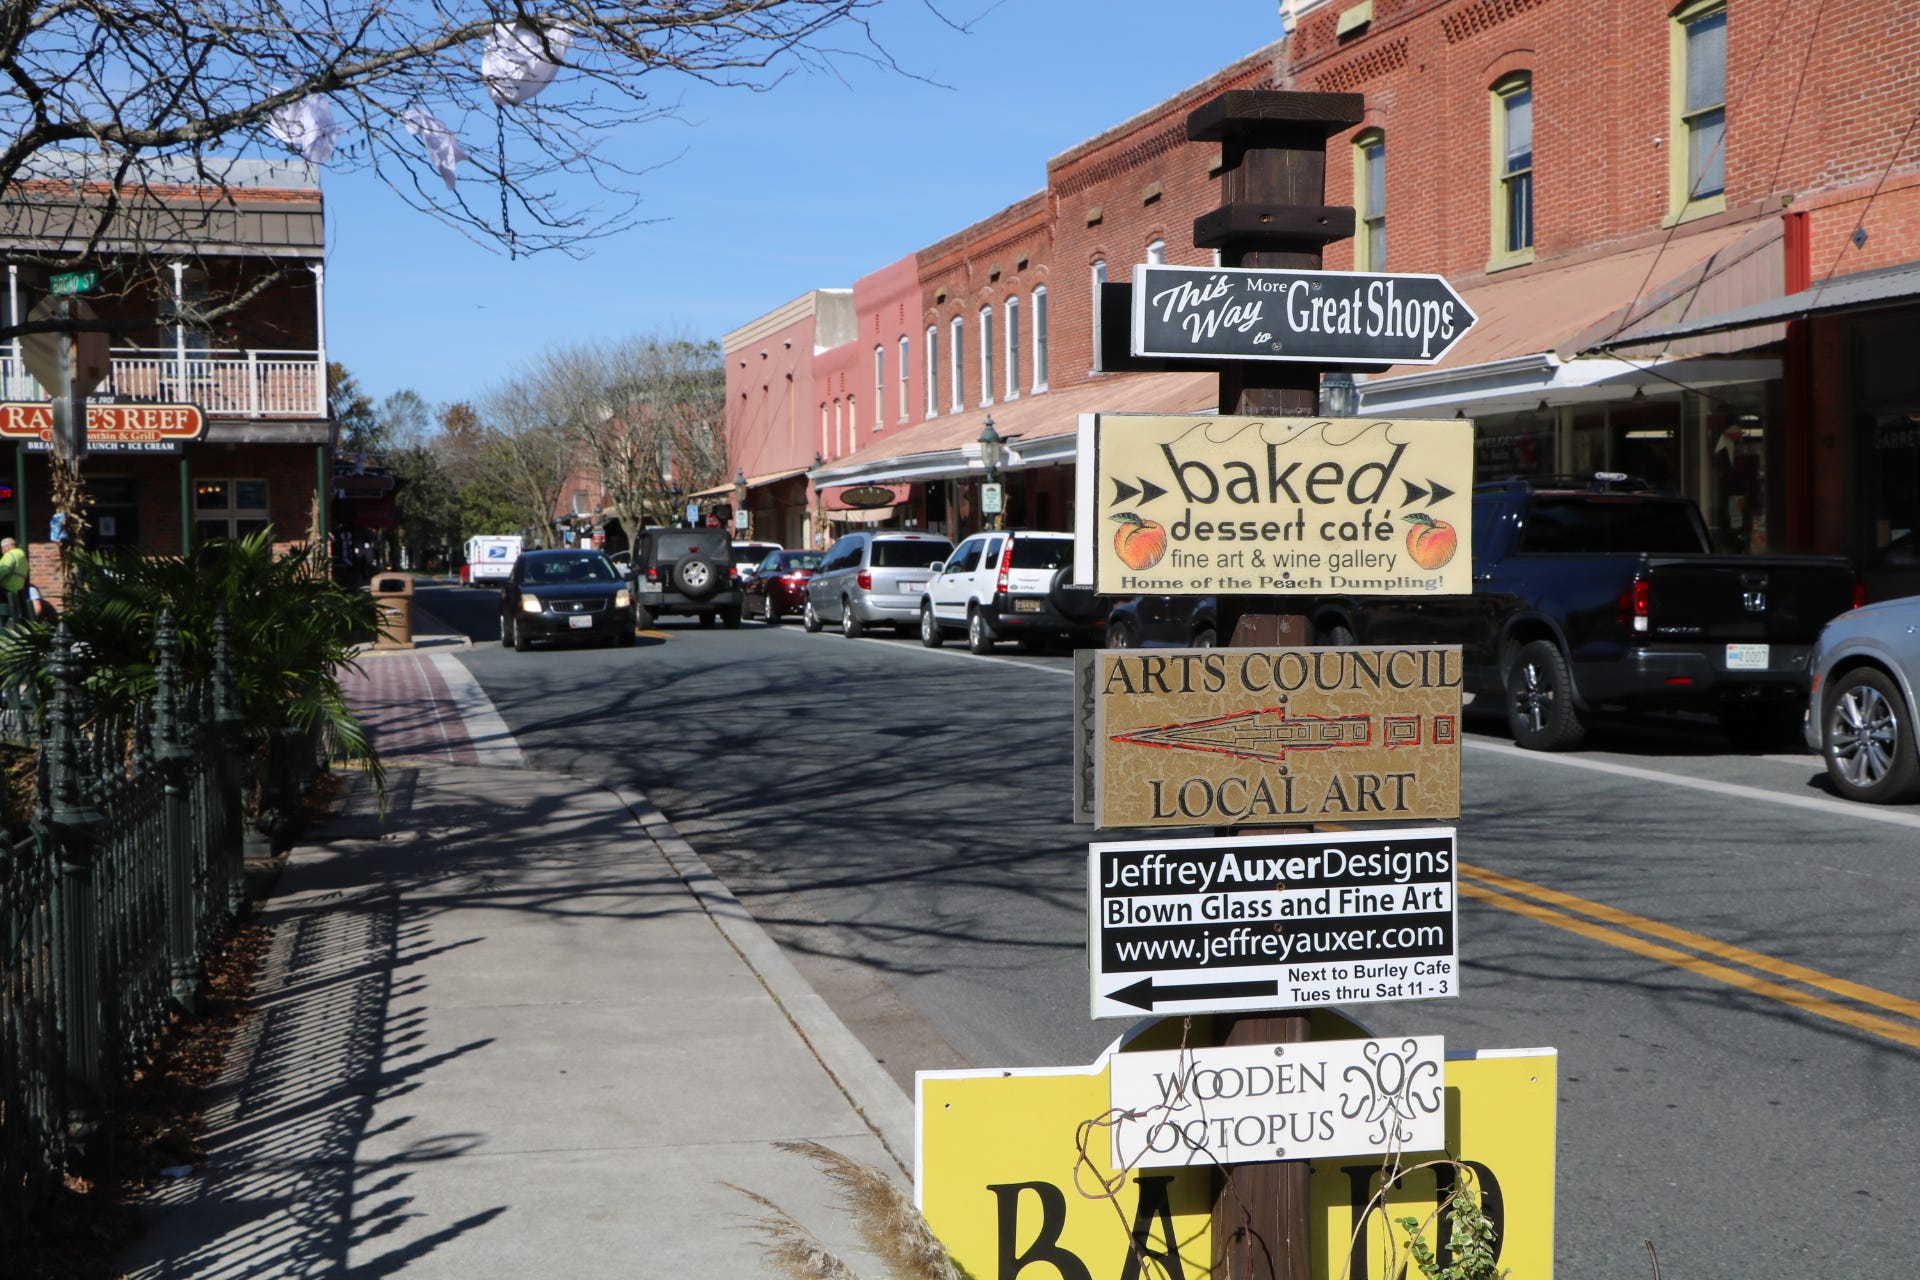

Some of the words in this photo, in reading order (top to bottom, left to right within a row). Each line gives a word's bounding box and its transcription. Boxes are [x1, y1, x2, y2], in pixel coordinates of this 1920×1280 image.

[83, 273, 95, 289] ST
[1247, 278, 1287, 293] More
[1153, 275, 1234, 322] This
[1183, 297, 1263, 343] Way
[1253, 331, 1273, 345] to
[7, 407, 116, 430] RAE'S
[122, 408, 189, 430] REEF
[87, 442, 118, 450] LUNCH
[128, 442, 143, 450] ICE
[144, 442, 174, 450] CREAM
[131, 431, 155, 440] Grill
[1158, 438, 1410, 505] baked
[1171, 508, 1305, 542] dessert
[1320, 509, 1394, 542] café
[1171, 549, 1209, 568] fine
[1216, 551, 1244, 568] art
[1252, 550, 1266, 568] &
[1274, 550, 1321, 568] wine
[1328, 550, 1397, 572] gallery
[1121, 576, 1183, 590] Home
[1190, 577, 1213, 590] of
[1219, 577, 1252, 590] the
[1260, 577, 1322, 590] Peach
[1102, 654, 1226, 694] ARTS
[1240, 650, 1462, 692] COUNCIL
[1149, 775, 1308, 819] LOCAL
[1320, 773, 1416, 814] ART
[1108, 899, 1192, 926] Blown
[1201, 894, 1273, 920] Glass
[1280, 889, 1330, 917] and
[1340, 888, 1394, 914] Fine
[1402, 886, 1443, 911] Art
[1116, 925, 1444, 965] www.jeffreyauxer.com
[1288, 966, 1327, 982] Next
[1332, 967, 1348, 980] to
[1354, 964, 1408, 982] Burley
[1413, 960, 1451, 976] Cafe
[1291, 987, 1332, 1002] Tues
[1336, 985, 1371, 1000] thru
[1376, 983, 1403, 998] Sat
[1408, 981, 1424, 996] 11
[1439, 980, 1449, 994] 3
[1153, 1061, 1328, 1106] WOODEN
[1146, 1110, 1335, 1153] OCTOPUS
